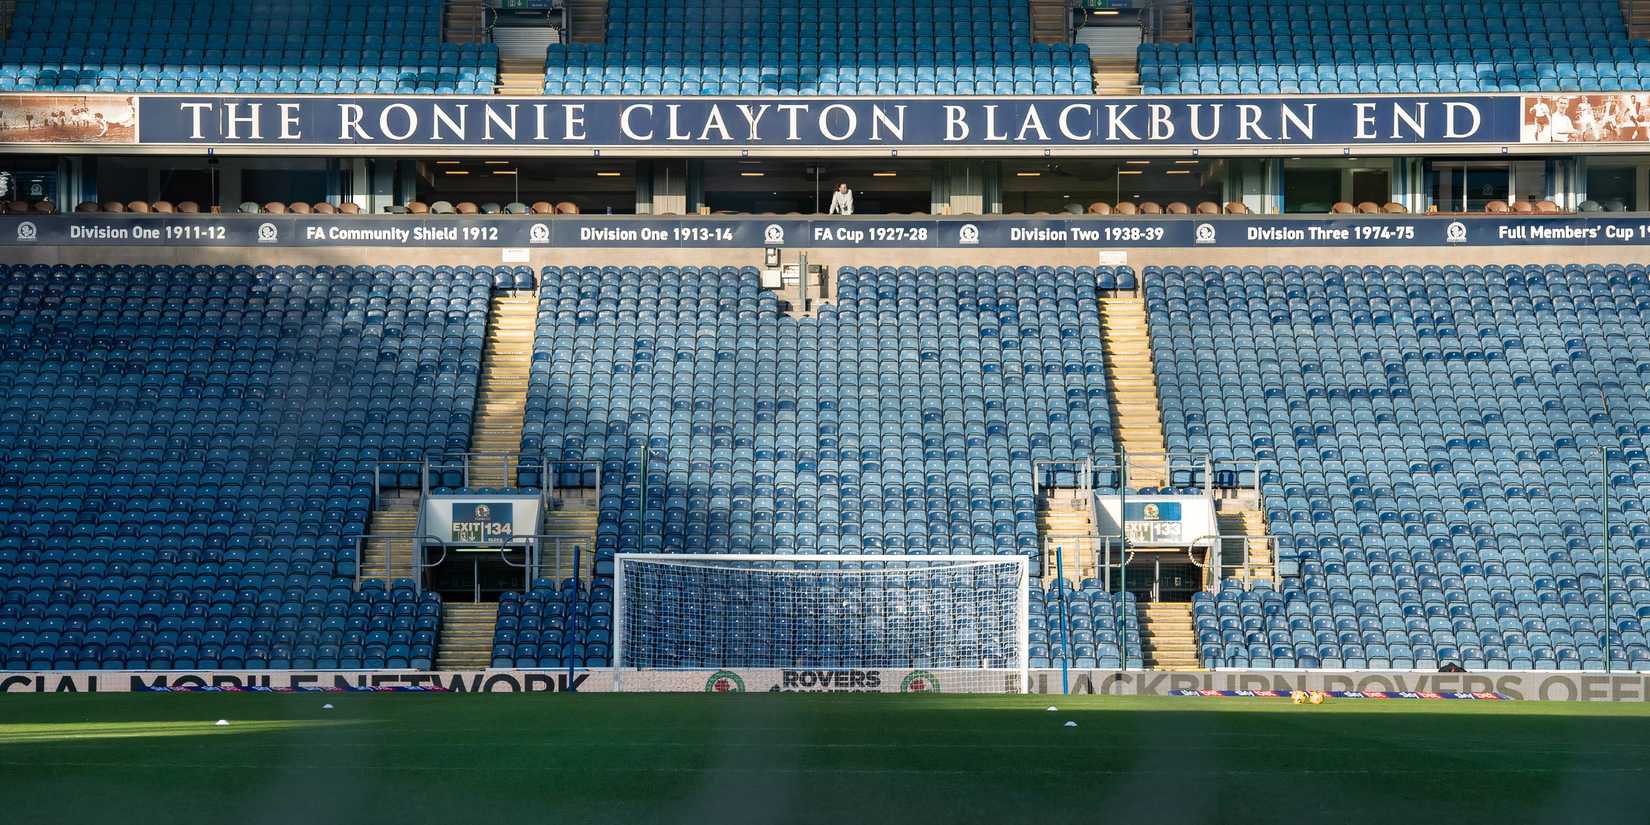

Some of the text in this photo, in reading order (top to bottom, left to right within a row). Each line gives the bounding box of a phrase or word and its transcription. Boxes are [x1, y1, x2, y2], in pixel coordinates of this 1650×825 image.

[180, 102, 1481, 141] THE RONNIE CLAYTON BLACKBURN END
[70, 225, 226, 240] Division One 1911-12
[306, 226, 498, 244] FA Community Shield 1912
[580, 226, 733, 241] Division One 1913-14
[814, 227, 928, 244] FA Cup 1927-28
[1010, 226, 1165, 241] Division Two 1938-39
[1247, 225, 1415, 241] Division Three 1974-75
[1498, 225, 1526, 239] Full
[1605, 225, 1634, 242] Cup
[1639, 225, 1650, 239] 1
[453, 522, 512, 535] EXIT 134
[783, 670, 881, 688] ROVERS
